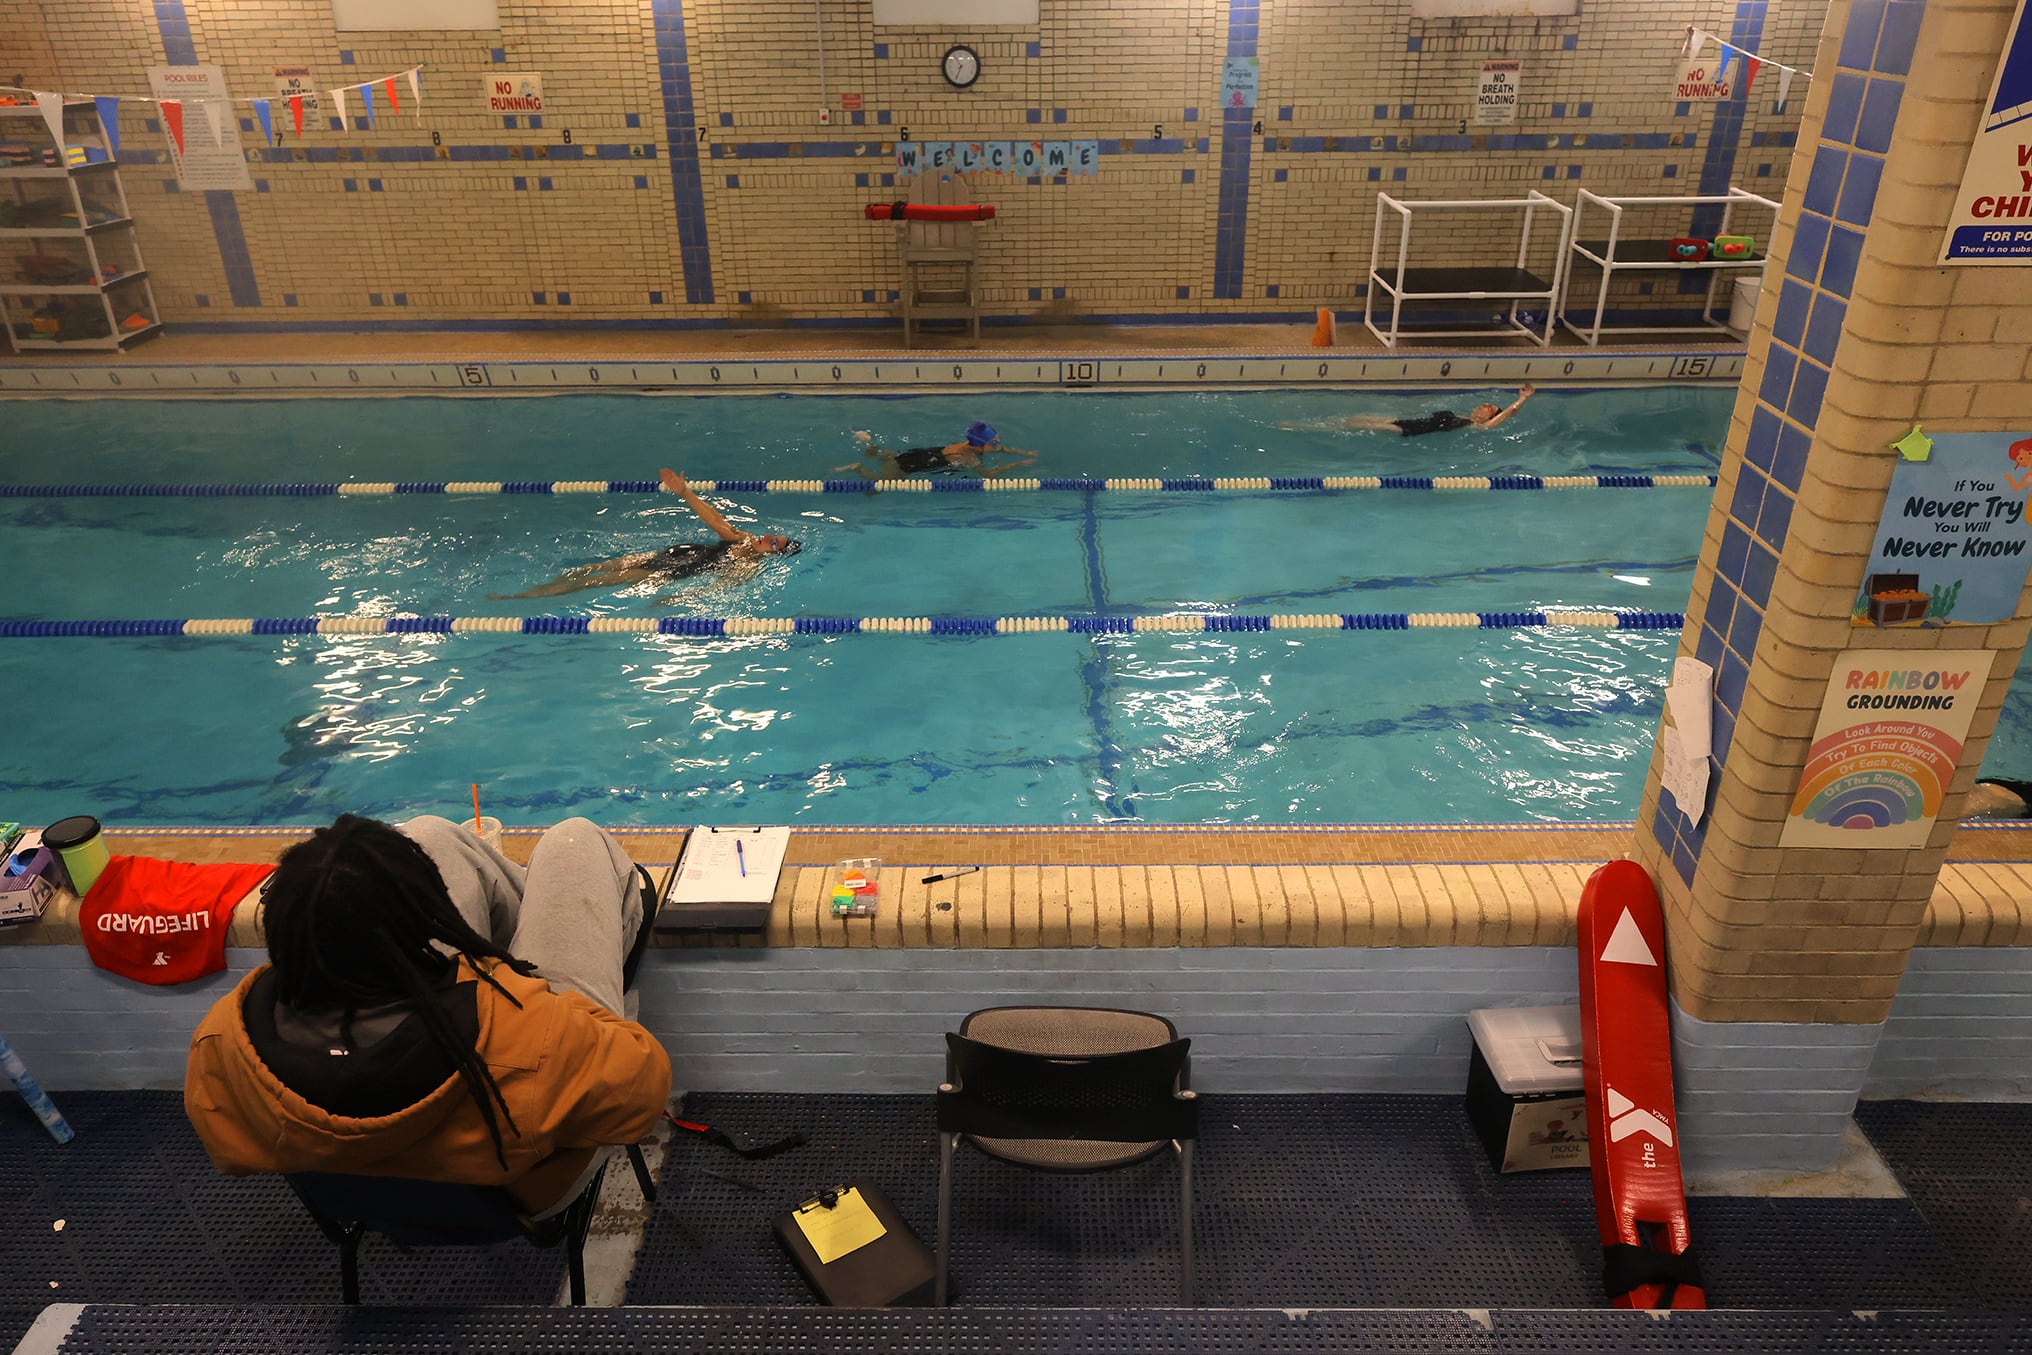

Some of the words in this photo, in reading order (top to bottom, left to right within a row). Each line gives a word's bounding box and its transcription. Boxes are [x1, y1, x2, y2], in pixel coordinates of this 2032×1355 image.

[1493, 73, 1506, 83] NO
[1687, 68, 1705, 81] NO
[288, 78, 301, 88] NO
[495, 81, 512, 95] NO
[1482, 84, 1514, 94] BREATH
[1677, 83, 1729, 97] RUNNING
[490, 97, 542, 111] RUNNING
[1478, 95, 1515, 105] HOLDING
[900, 126, 909, 141] 6
[1154, 125, 1162, 139] 5
[1253, 121, 1262, 135] 4
[1458, 120, 1467, 134] 3
[275, 132, 283, 147] 7
[432, 131, 441, 146] 8
[562, 129, 572, 144] 8
[698, 128, 706, 142] 7
[901, 149, 1091, 168] WELCOME
[1971, 196, 2032, 218] CHI
[1983, 231, 2011, 242] FOR
[1066, 363, 1093, 380] 10
[1676, 358, 1707, 376] 15
[464, 367, 483, 384] 5
[1954, 479, 1967, 493] If
[1970, 480, 1995, 492] You
[1903, 496, 1980, 518] Never
[1985, 496, 2024, 524] Try
[1934, 522, 1959, 533] You
[1965, 521, 1991, 533] Will
[1882, 537, 1958, 558] Never
[1961, 537, 2027, 558] Know
[1845, 670, 1971, 690] RAINBOW
[1847, 694, 1954, 710] GROUNDING
[1845, 727, 1871, 739] Look
[1874, 725, 1913, 735] Around
[1916, 726, 1935, 740] You
[1825, 749, 1848, 763] Try
[1851, 743, 1866, 753] To
[1870, 740, 1896, 750] Find
[1899, 741, 1938, 764] Objects
[1839, 762, 1854, 775] Of
[1859, 758, 1888, 768] Each
[1890, 759, 1919, 775] Color
[1823, 783, 1843, 798] Of
[1845, 775, 1869, 787] The
[1873, 774, 1917, 799] Rainbow
[96, 910, 210, 935] LIFEGUARD
[1652, 1108, 1669, 1125] YMCA
[1551, 1144, 1582, 1153] POOL
[1641, 1142, 1656, 1169] the
